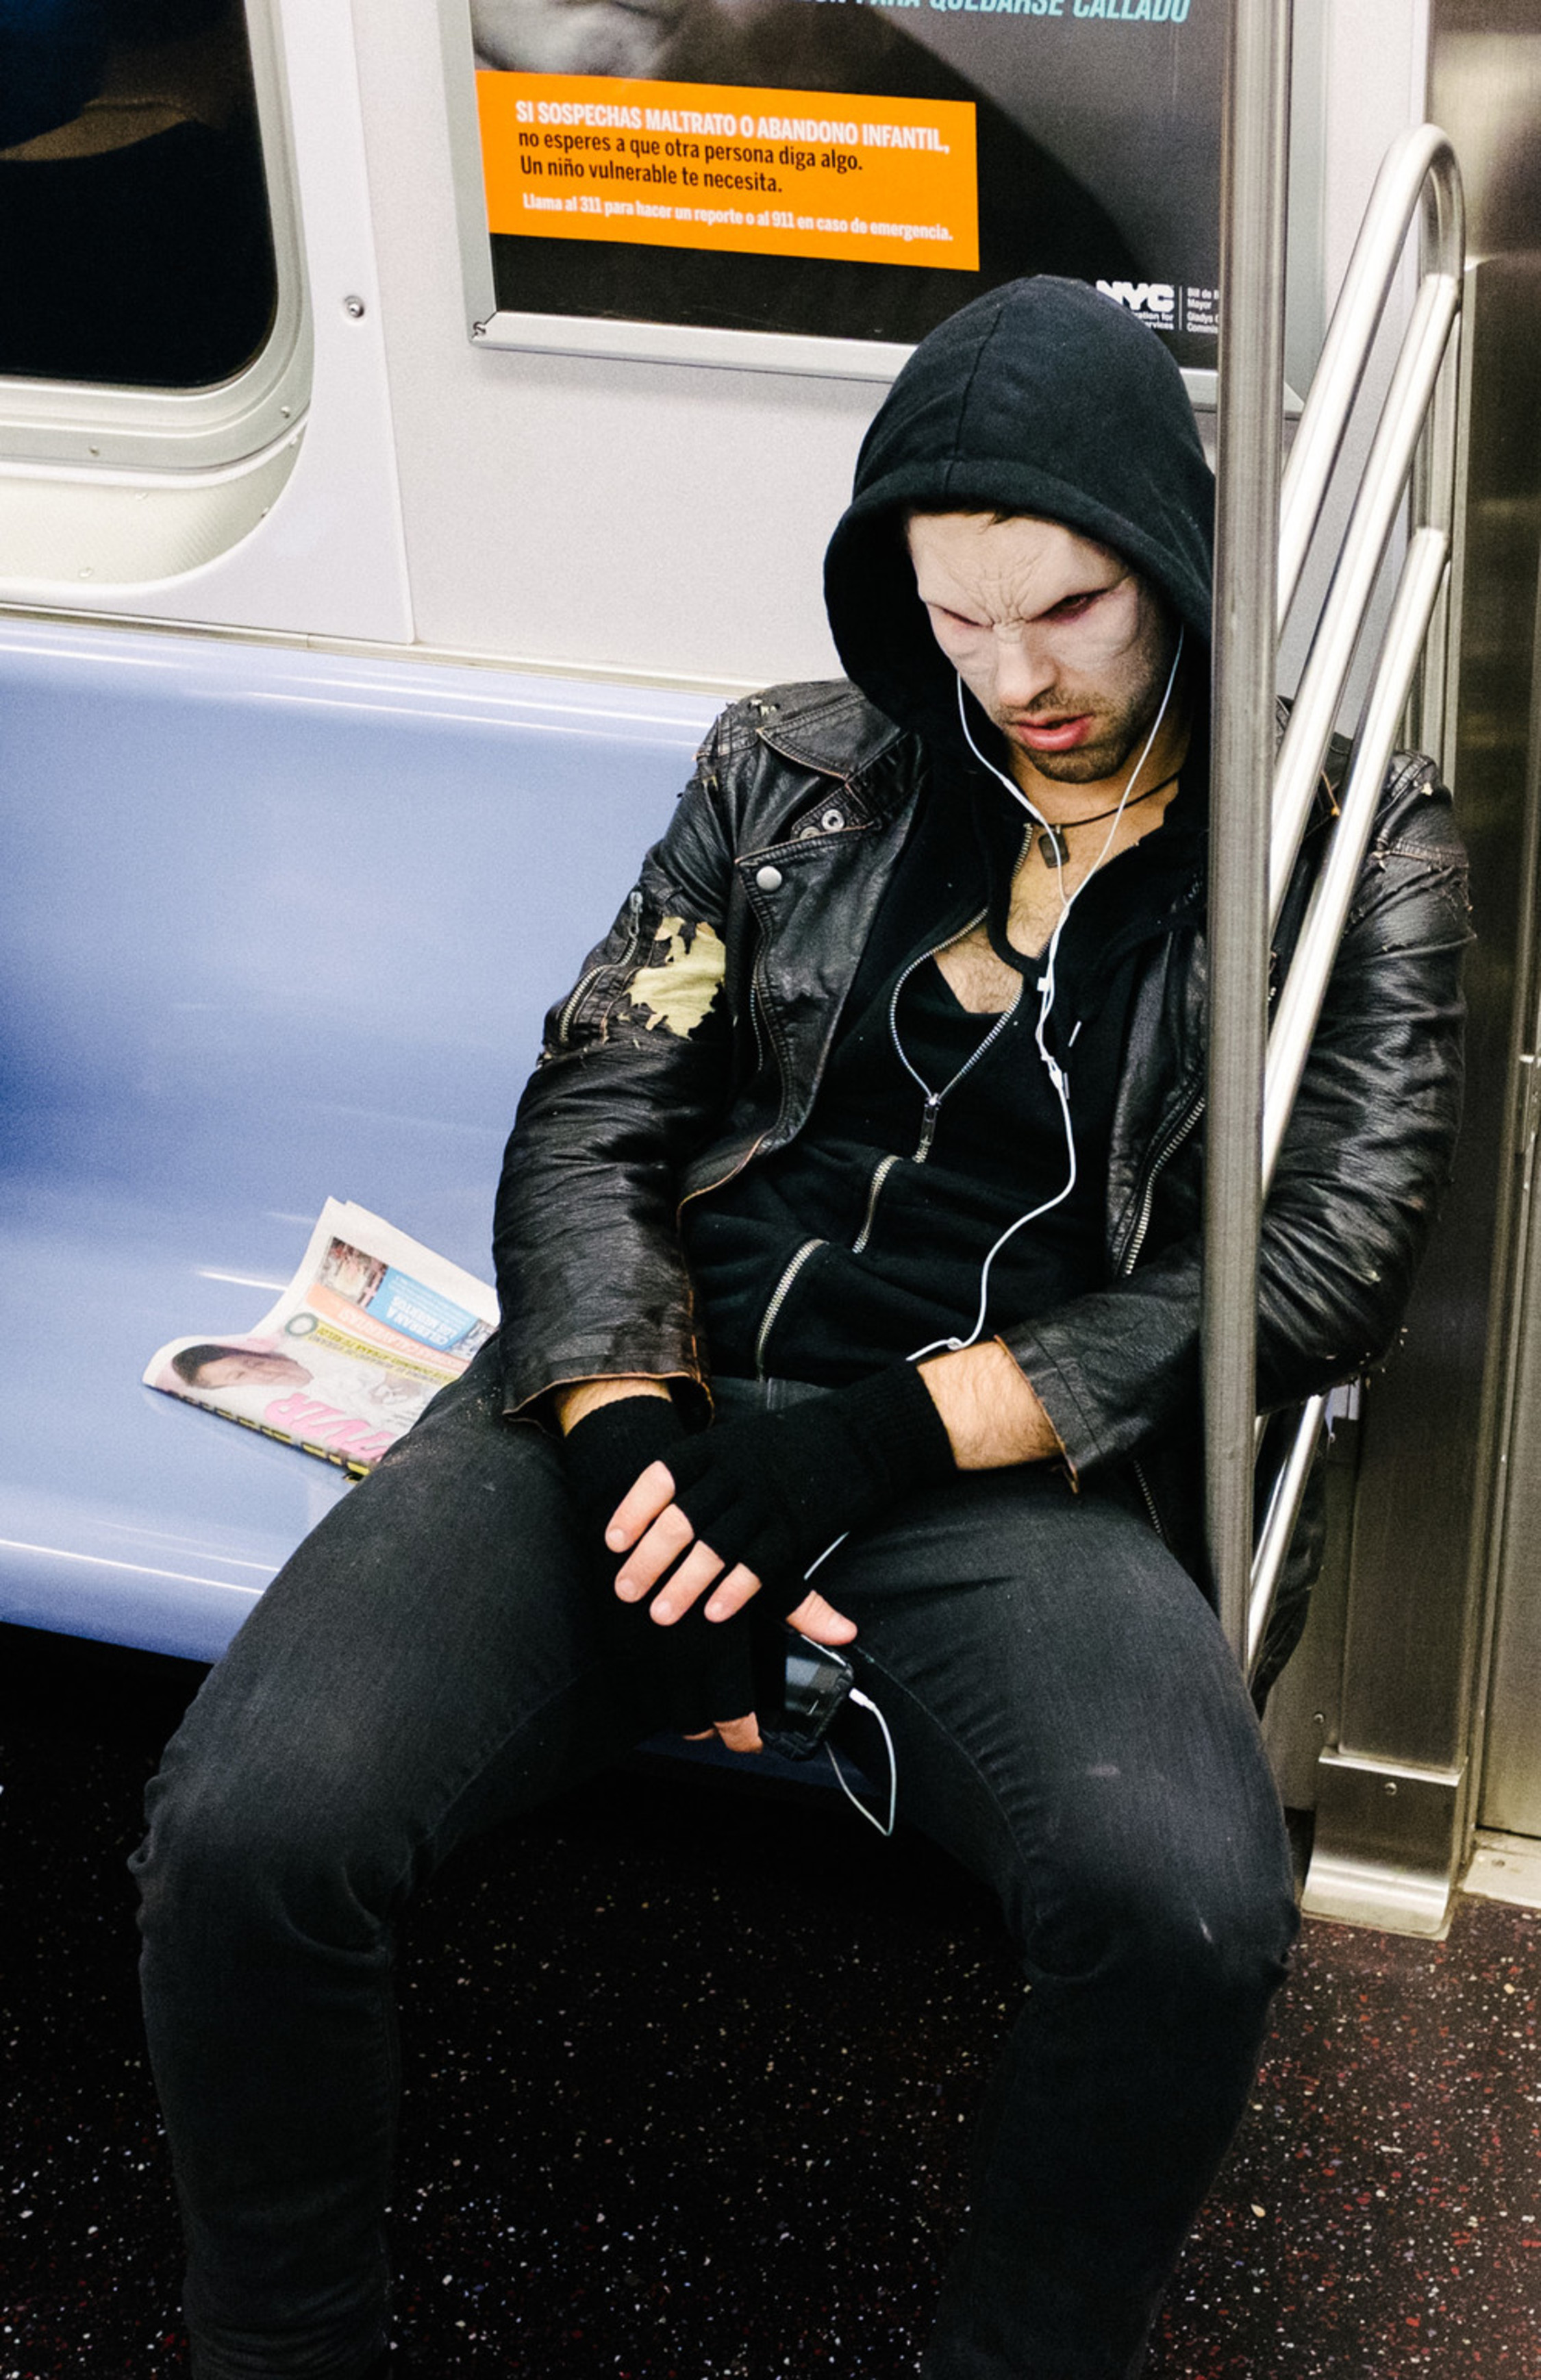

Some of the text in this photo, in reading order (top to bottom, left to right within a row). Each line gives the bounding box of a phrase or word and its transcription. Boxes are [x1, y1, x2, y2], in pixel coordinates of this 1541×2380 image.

[1073, 0, 1191, 23] CALLADO
[516, 100, 951, 155] SI SOSPECHAS MALTRATO O ABANDONO INFANTIL,
[518, 132, 864, 175] no esperes a que otra persona diga algo.
[520, 156, 784, 193] Un niño vulnerable te necesita.
[523, 193, 954, 243] Llama al 311 para hacer un reporte o al 911 en caso de emergencia.
[1096, 280, 1175, 312] NYC
